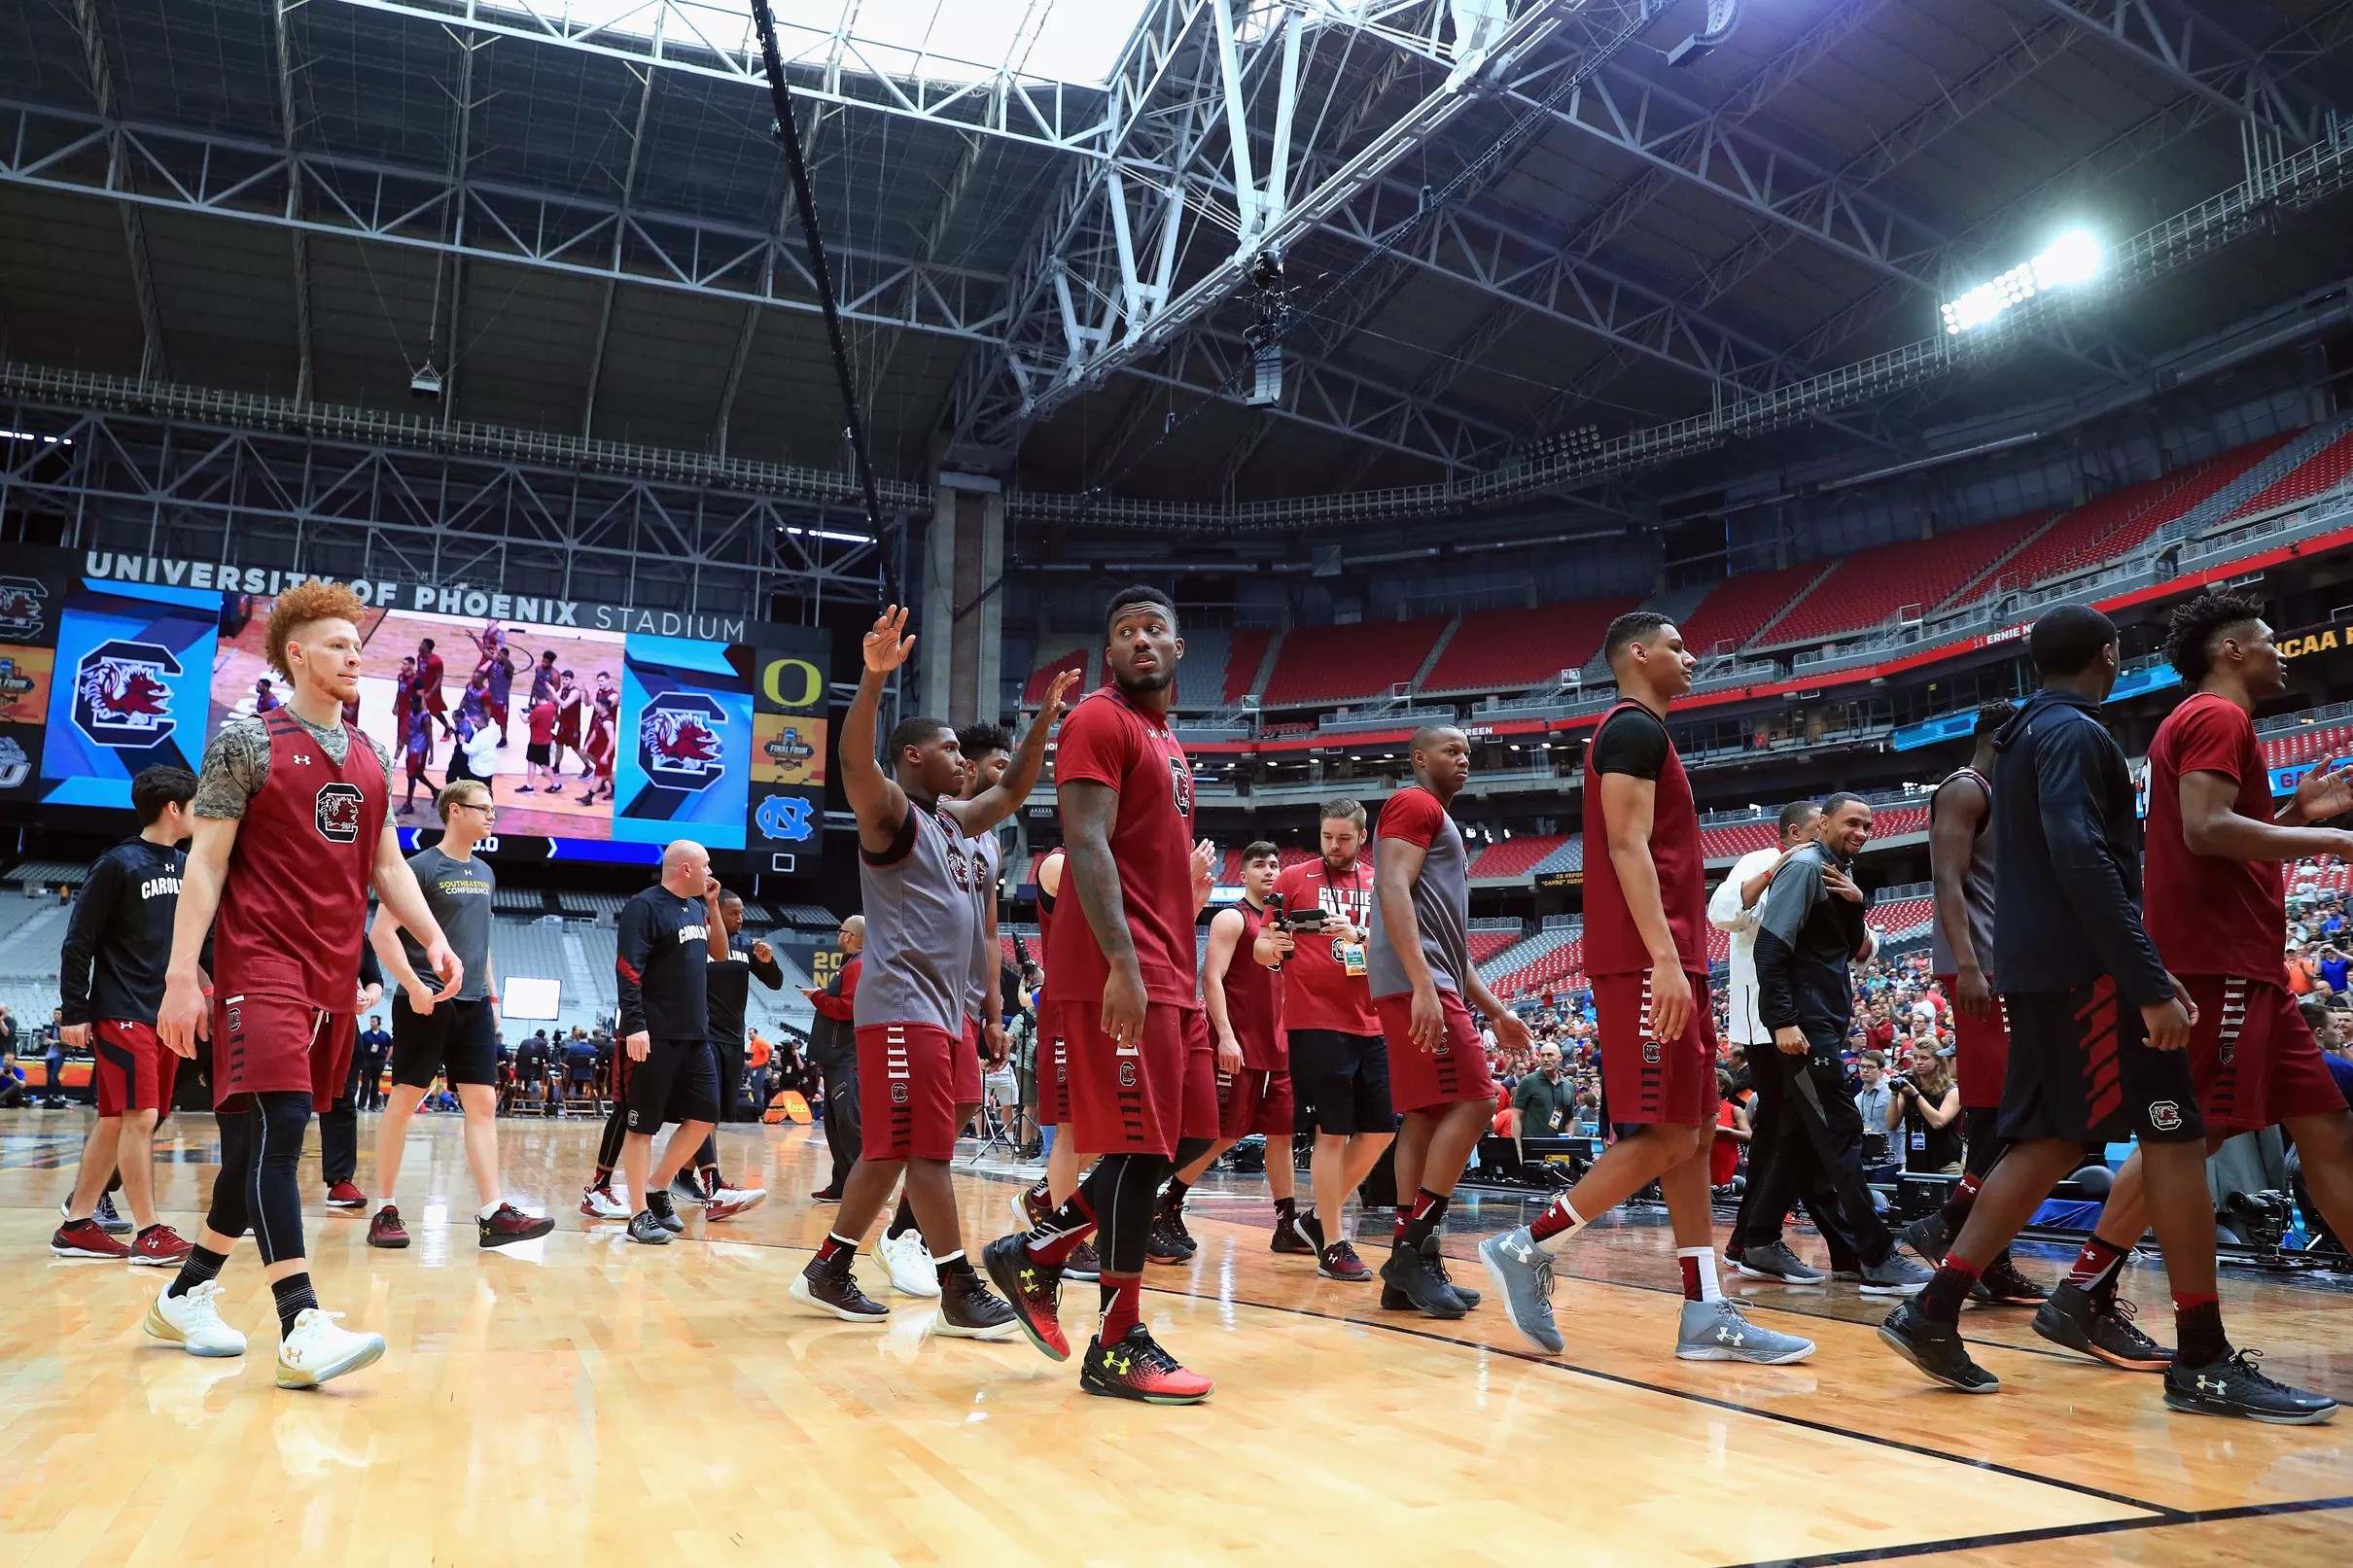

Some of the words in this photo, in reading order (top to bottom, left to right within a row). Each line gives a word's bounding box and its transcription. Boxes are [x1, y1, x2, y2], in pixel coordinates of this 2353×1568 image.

[350, 578, 397, 608] OF
[414, 585, 579, 627] PHOENIX
[595, 605, 744, 644] STADIUM
[1986, 628, 2020, 645] ERNIE
[769, 744, 790, 753] FINAL
[790, 745, 808, 755] FOUR
[1347, 889, 1372, 906] THE
